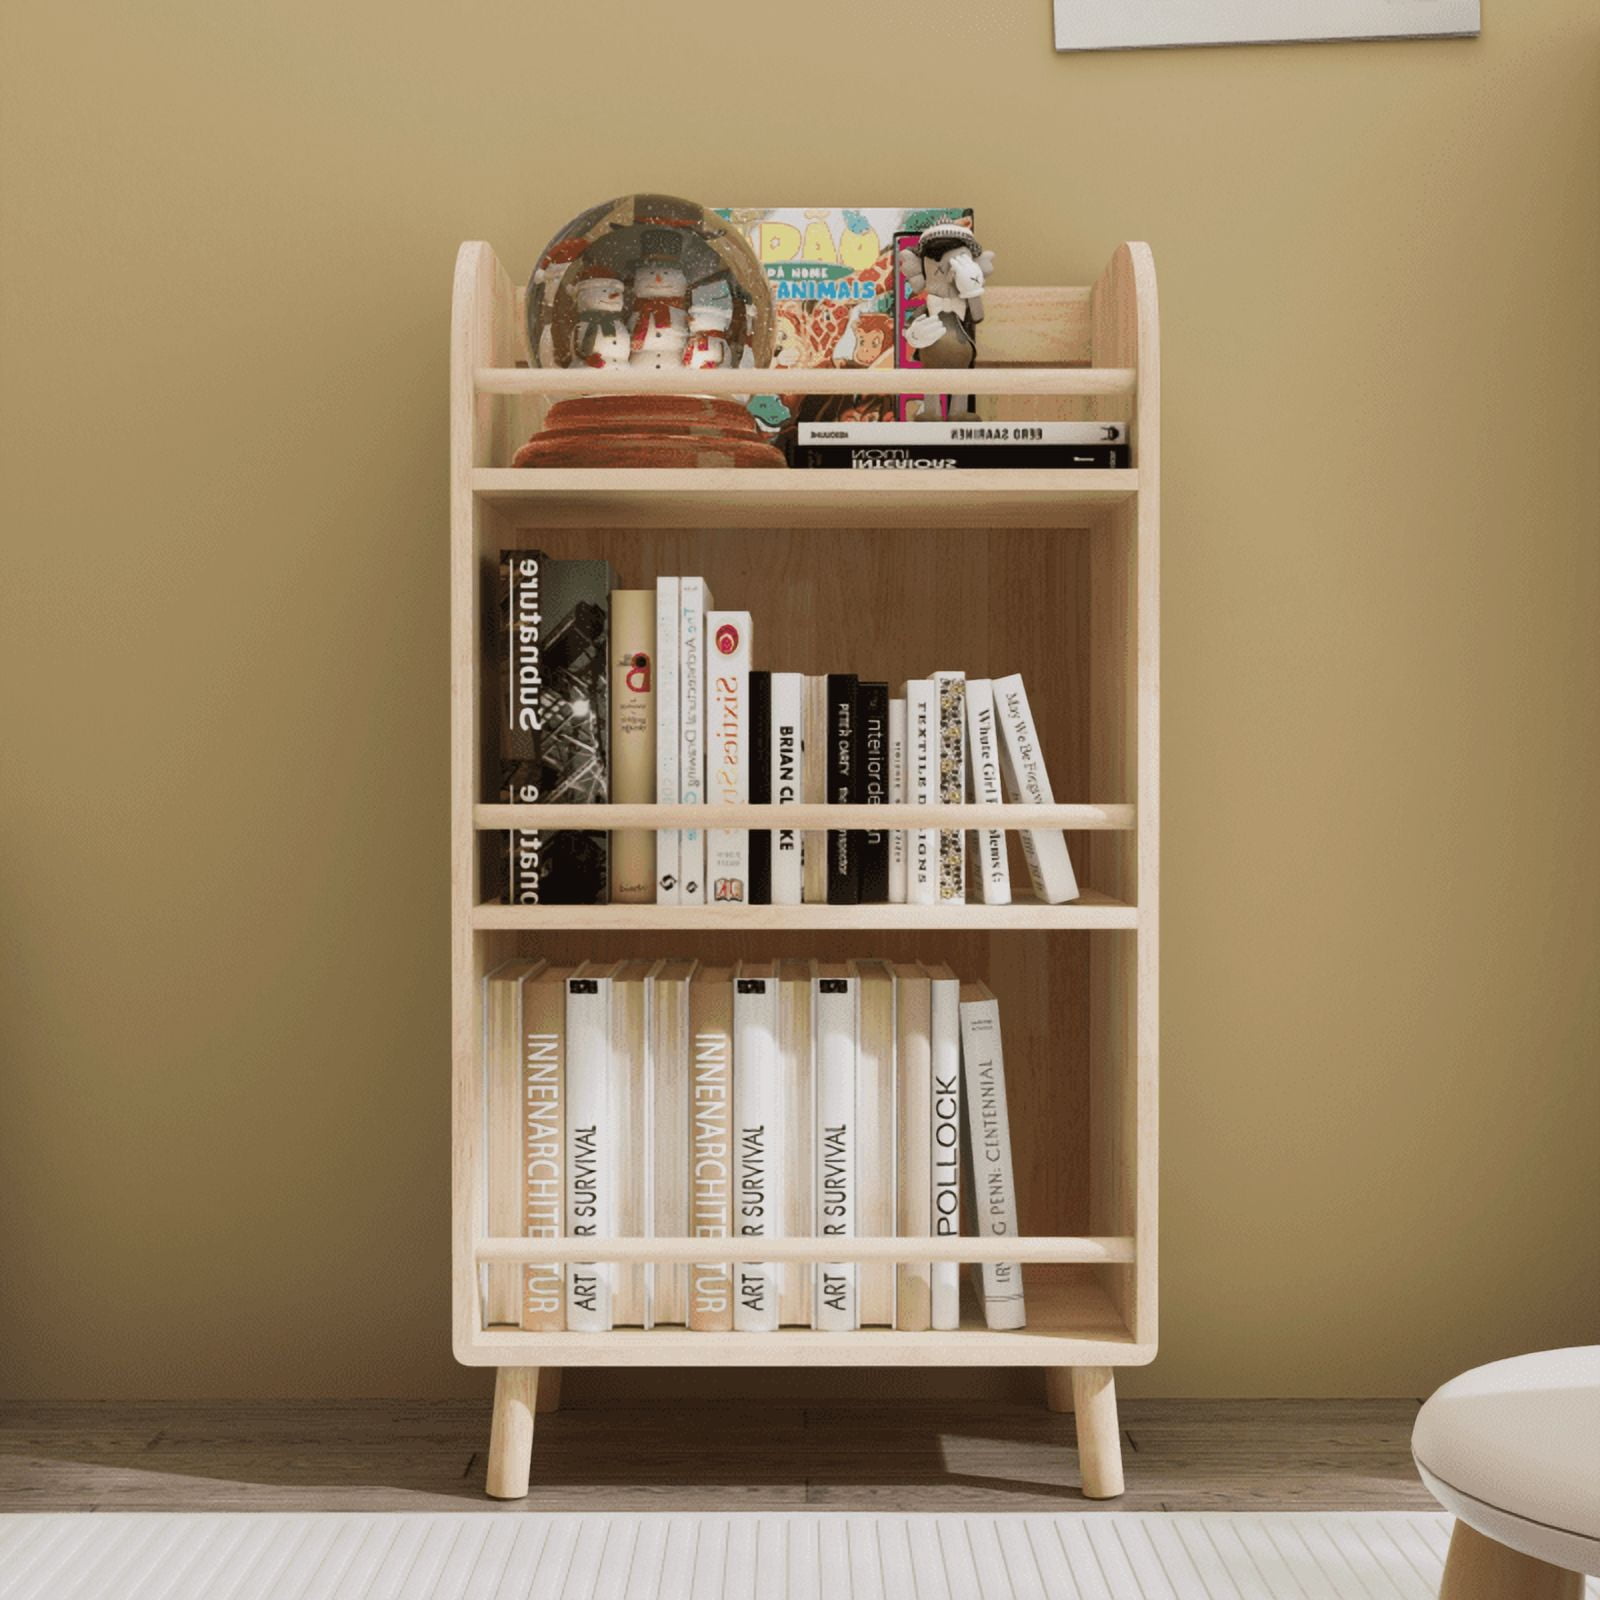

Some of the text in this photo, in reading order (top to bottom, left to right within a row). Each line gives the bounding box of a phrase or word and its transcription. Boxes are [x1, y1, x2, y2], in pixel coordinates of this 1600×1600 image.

[777, 281, 876, 300] ANIMAIS
[791, 267, 829, 279] NOME
[779, 726, 794, 851] BRIAN CLKE
[917, 701, 927, 883] TEXTILE DIGNS
[982, 763, 997, 794] Girl
[935, 1075, 959, 1236] POLLOCK
[977, 1059, 1002, 1162] CENTENNIAL
[527, 1033, 560, 1314] INNENARCHITETUR
[574, 1125, 598, 1217] SURVIVAL
[695, 1033, 728, 1314] INNENARCHITETUR
[742, 1125, 765, 1217] SURVIVAL
[824, 1123, 847, 1217] SURVIVAL
[573, 1274, 598, 1312] ART
[741, 1274, 765, 1312] ART
[823, 1273, 847, 1311] ART
